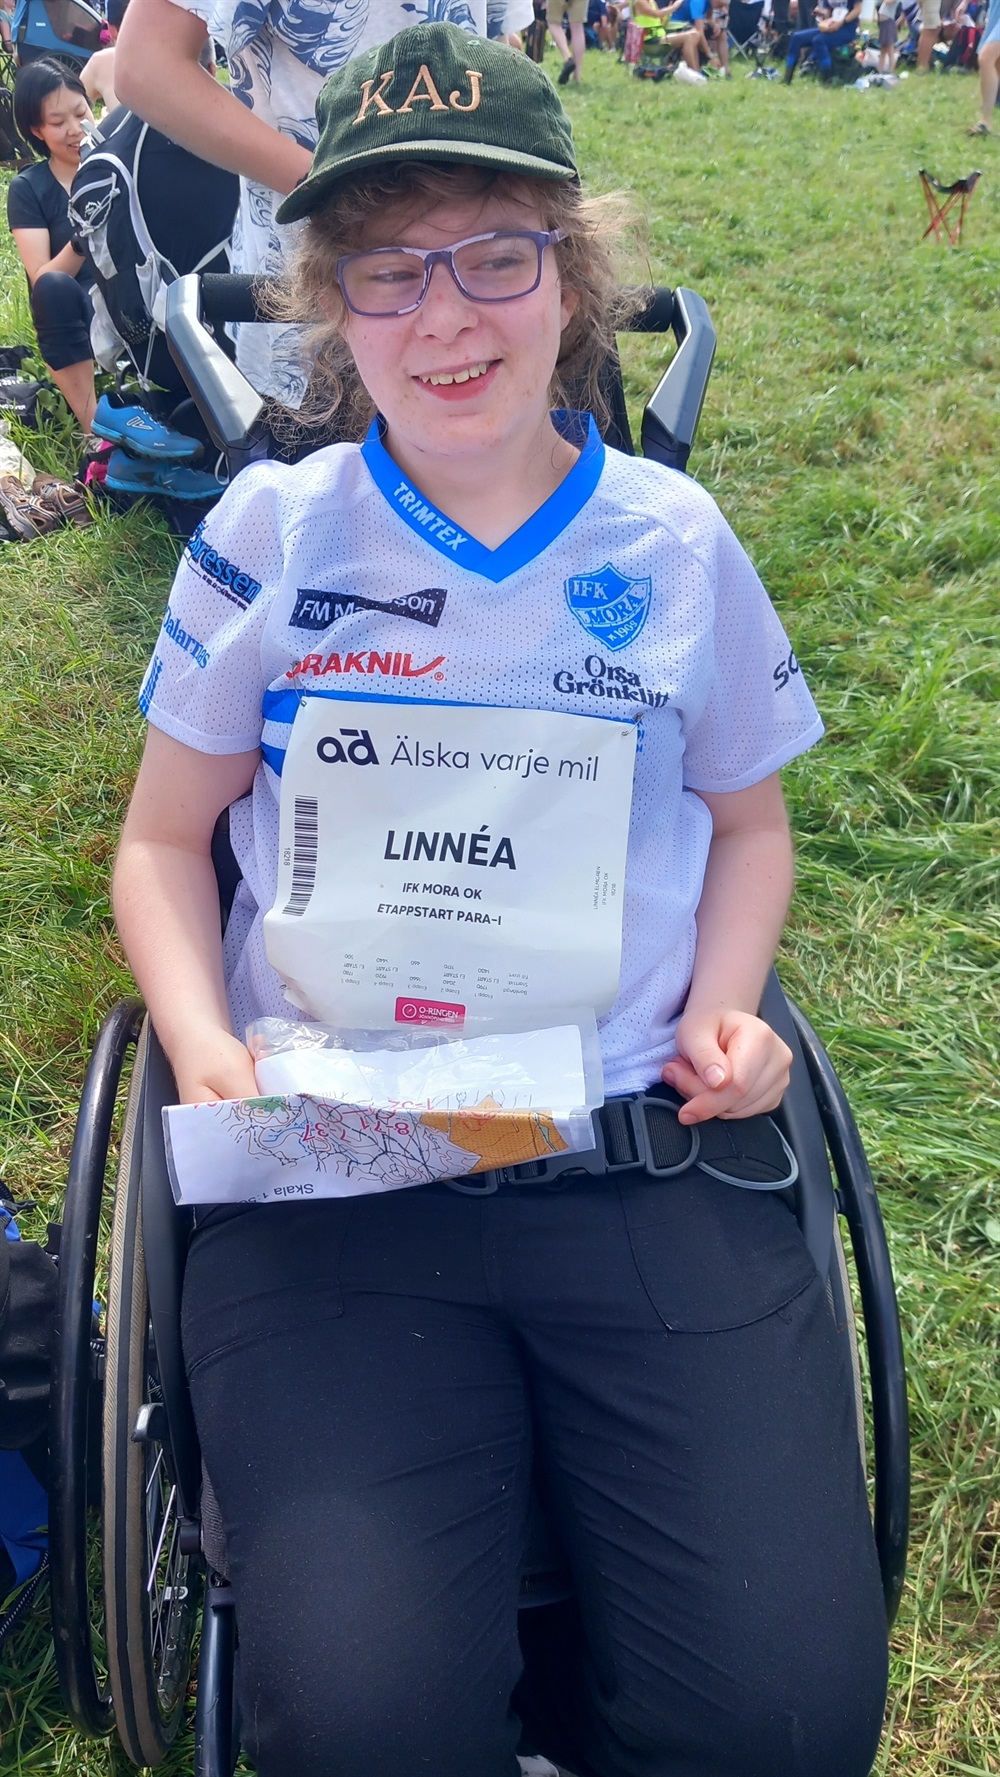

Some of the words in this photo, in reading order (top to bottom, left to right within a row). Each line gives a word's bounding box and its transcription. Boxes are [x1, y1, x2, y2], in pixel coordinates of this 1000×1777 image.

[352, 64, 483, 126] KAJ
[393, 481, 469, 551] TRIMTEX
[572, 580, 609, 600] IFK
[297, 599, 330, 622] FM
[585, 593, 644, 624] MORA
[584, 654, 642, 687] Orsa
[390, 734, 470, 769] Älska
[480, 748, 550, 778] varje
[557, 755, 599, 782] mil
[283, 847, 291, 867] 18218
[384, 824, 517, 870] LINNÉA
[402, 882, 420, 893] IFK
[422, 883, 460, 897] MORA
[463, 887, 482, 900] OK
[377, 903, 454, 920] ETAPPSTART
[456, 910, 502, 925] PARA-I
[419, 1006, 459, 1018] O-RINGEN
[302, 1122, 352, 1143] 7-37
[359, 1116, 410, 1136] 8-71
[273, 1183, 314, 1197] Skala
